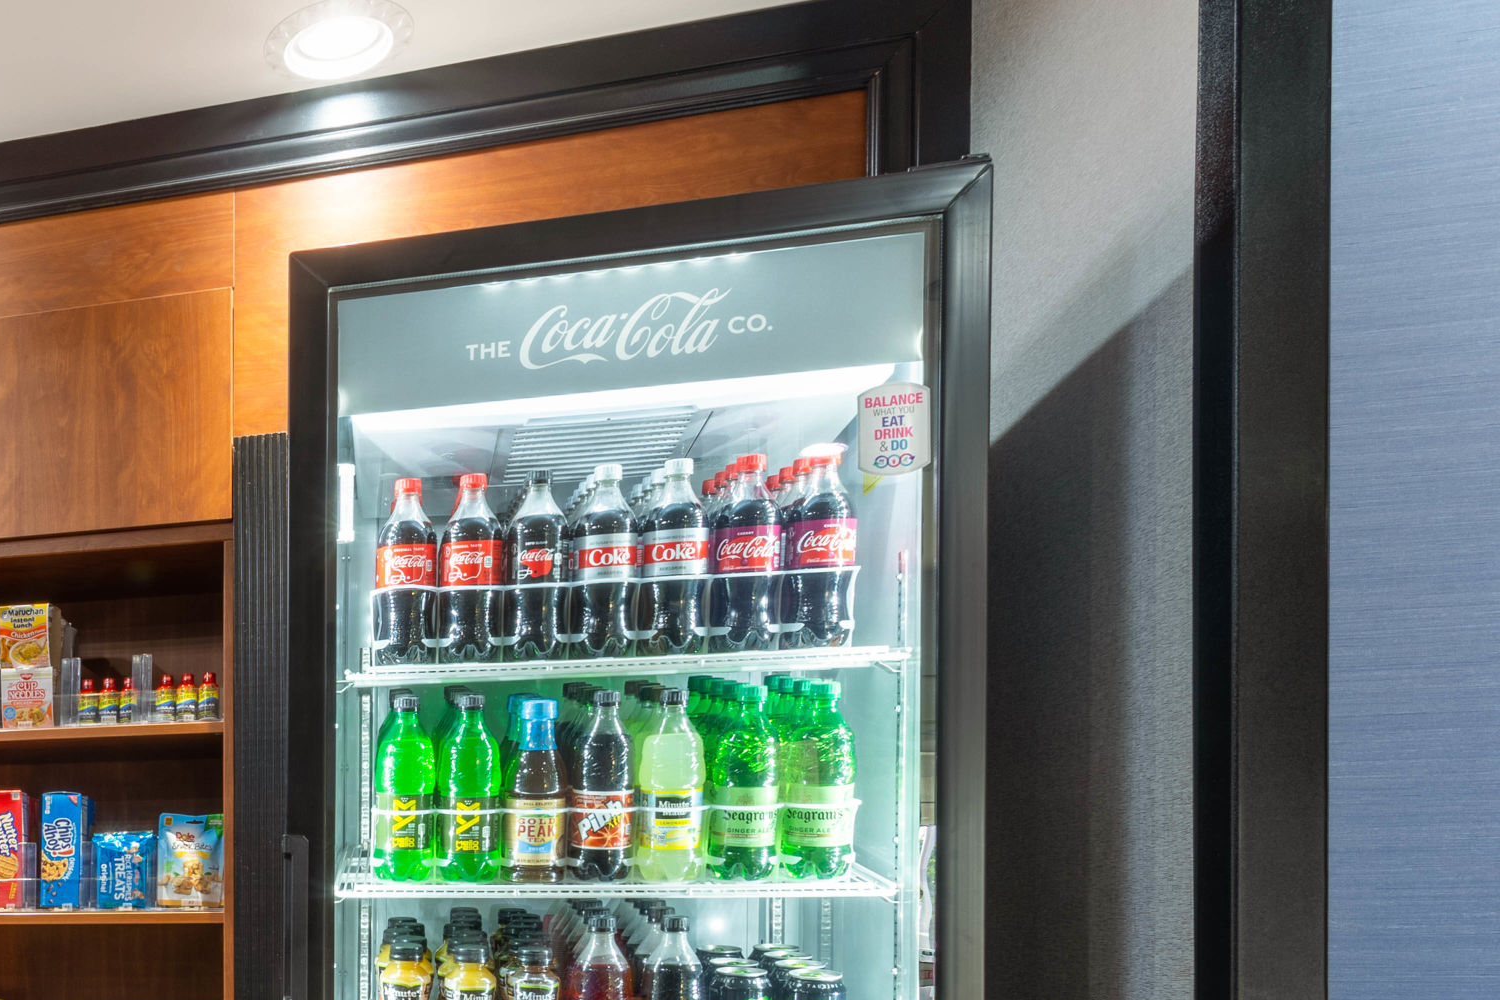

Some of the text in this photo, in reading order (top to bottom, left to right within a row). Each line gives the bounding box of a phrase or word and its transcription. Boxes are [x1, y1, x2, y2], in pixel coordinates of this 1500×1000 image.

[465, 287, 773, 370] THE Coca-Cola CO.
[864, 392, 924, 409] BALANCE
[873, 405, 915, 417] WHAT YOU
[882, 415, 905, 427] EAT
[874, 427, 913, 441] DRINK
[879, 439, 908, 452] & DO
[589, 549, 631, 566] Coke
[652, 543, 696, 562] Coke
[8, 608, 44, 617] Maruchan
[11, 630, 34, 639] Chicken
[16, 681, 38, 690] CUP
[8, 689, 46, 700] NOODLES
[0, 811, 18, 852] Nutter
[54, 818, 71, 850] Chips
[175, 831, 195, 841] Dole
[518, 825, 555, 837] PEAK
[114, 856, 125, 901] TREATS
